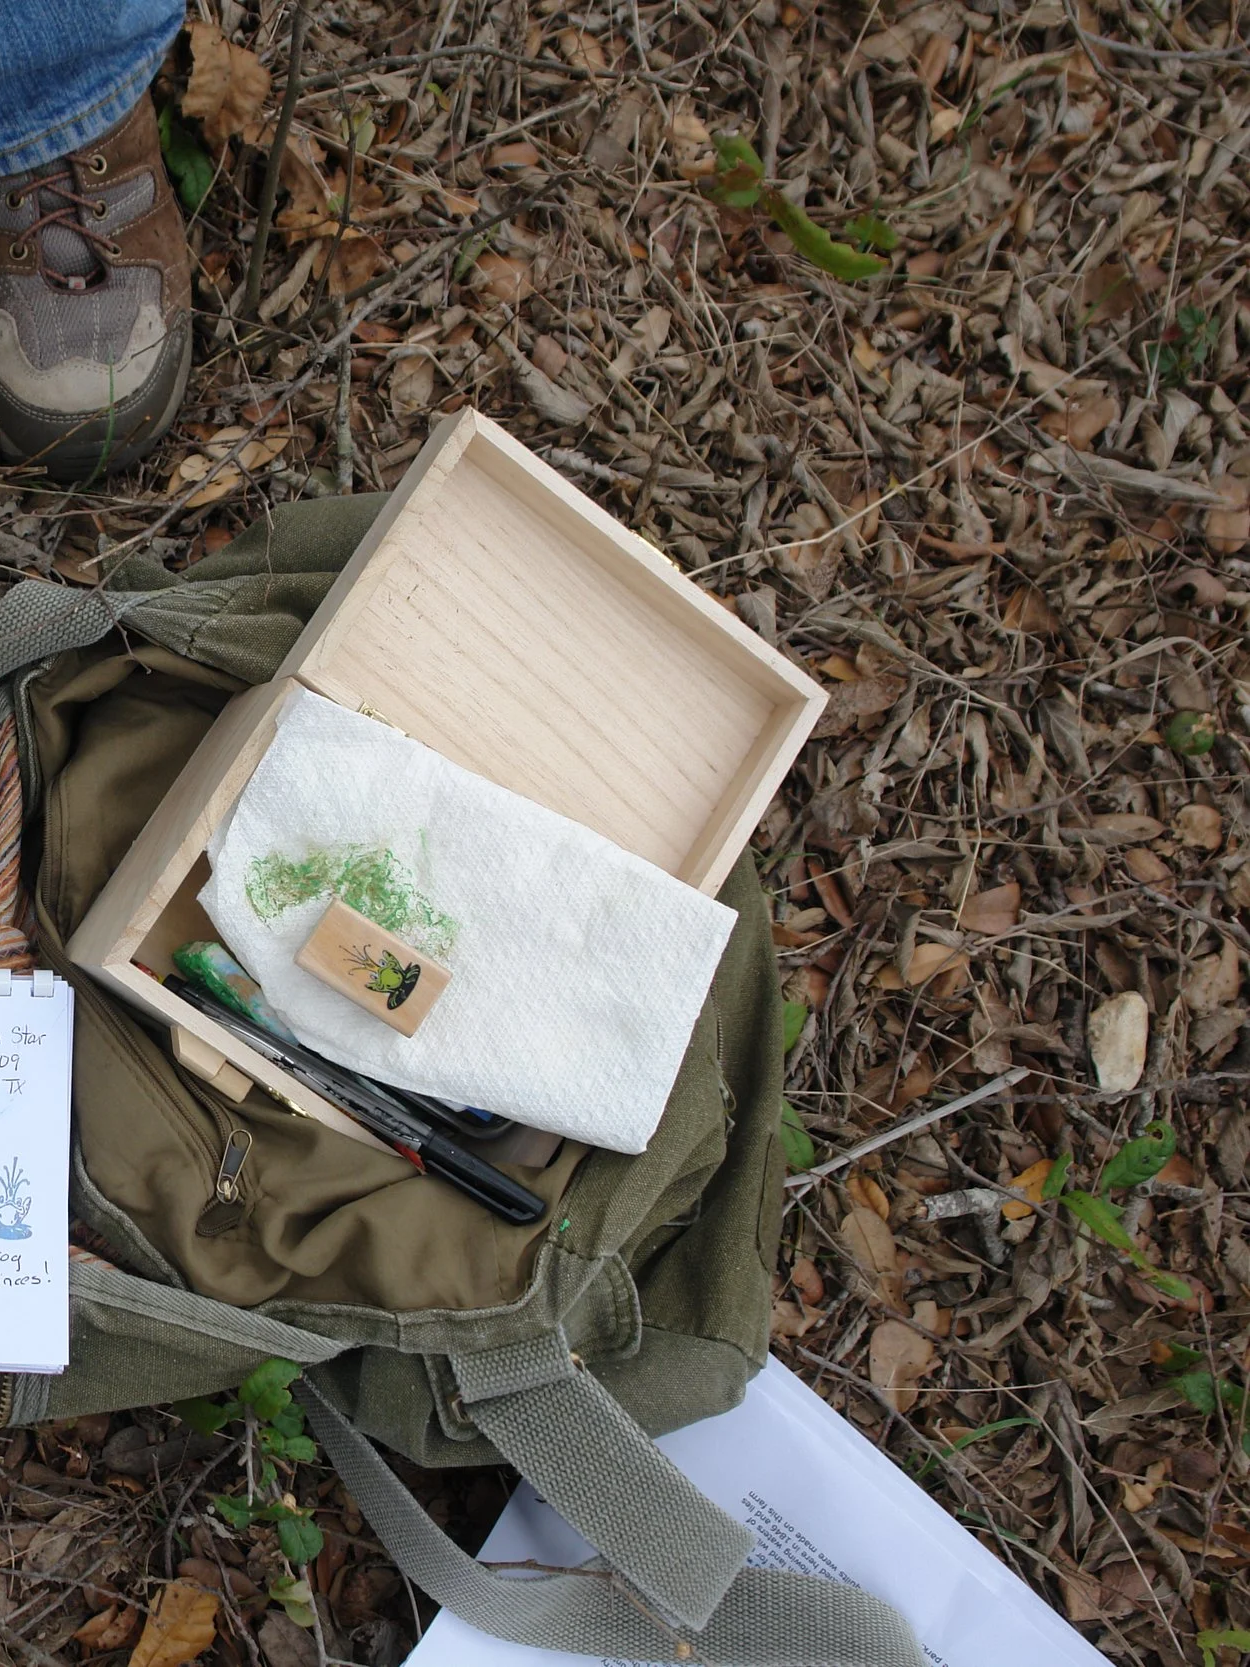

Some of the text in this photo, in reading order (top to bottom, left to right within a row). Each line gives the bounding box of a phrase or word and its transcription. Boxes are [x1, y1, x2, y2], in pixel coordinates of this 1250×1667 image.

[10, 1024, 47, 1046] Star
[1, 1077, 27, 1096] TX
[748, 1490, 768, 1510] farm
[754, 1510, 771, 1525] and
[768, 1507, 783, 1523] this
[756, 1524, 782, 1549] waters
[771, 1524, 792, 1544] 1846
[783, 1521, 795, 1533] on
[795, 1532, 818, 1553] made
[801, 1550, 819, 1570] here
[818, 1552, 838, 1572] were
